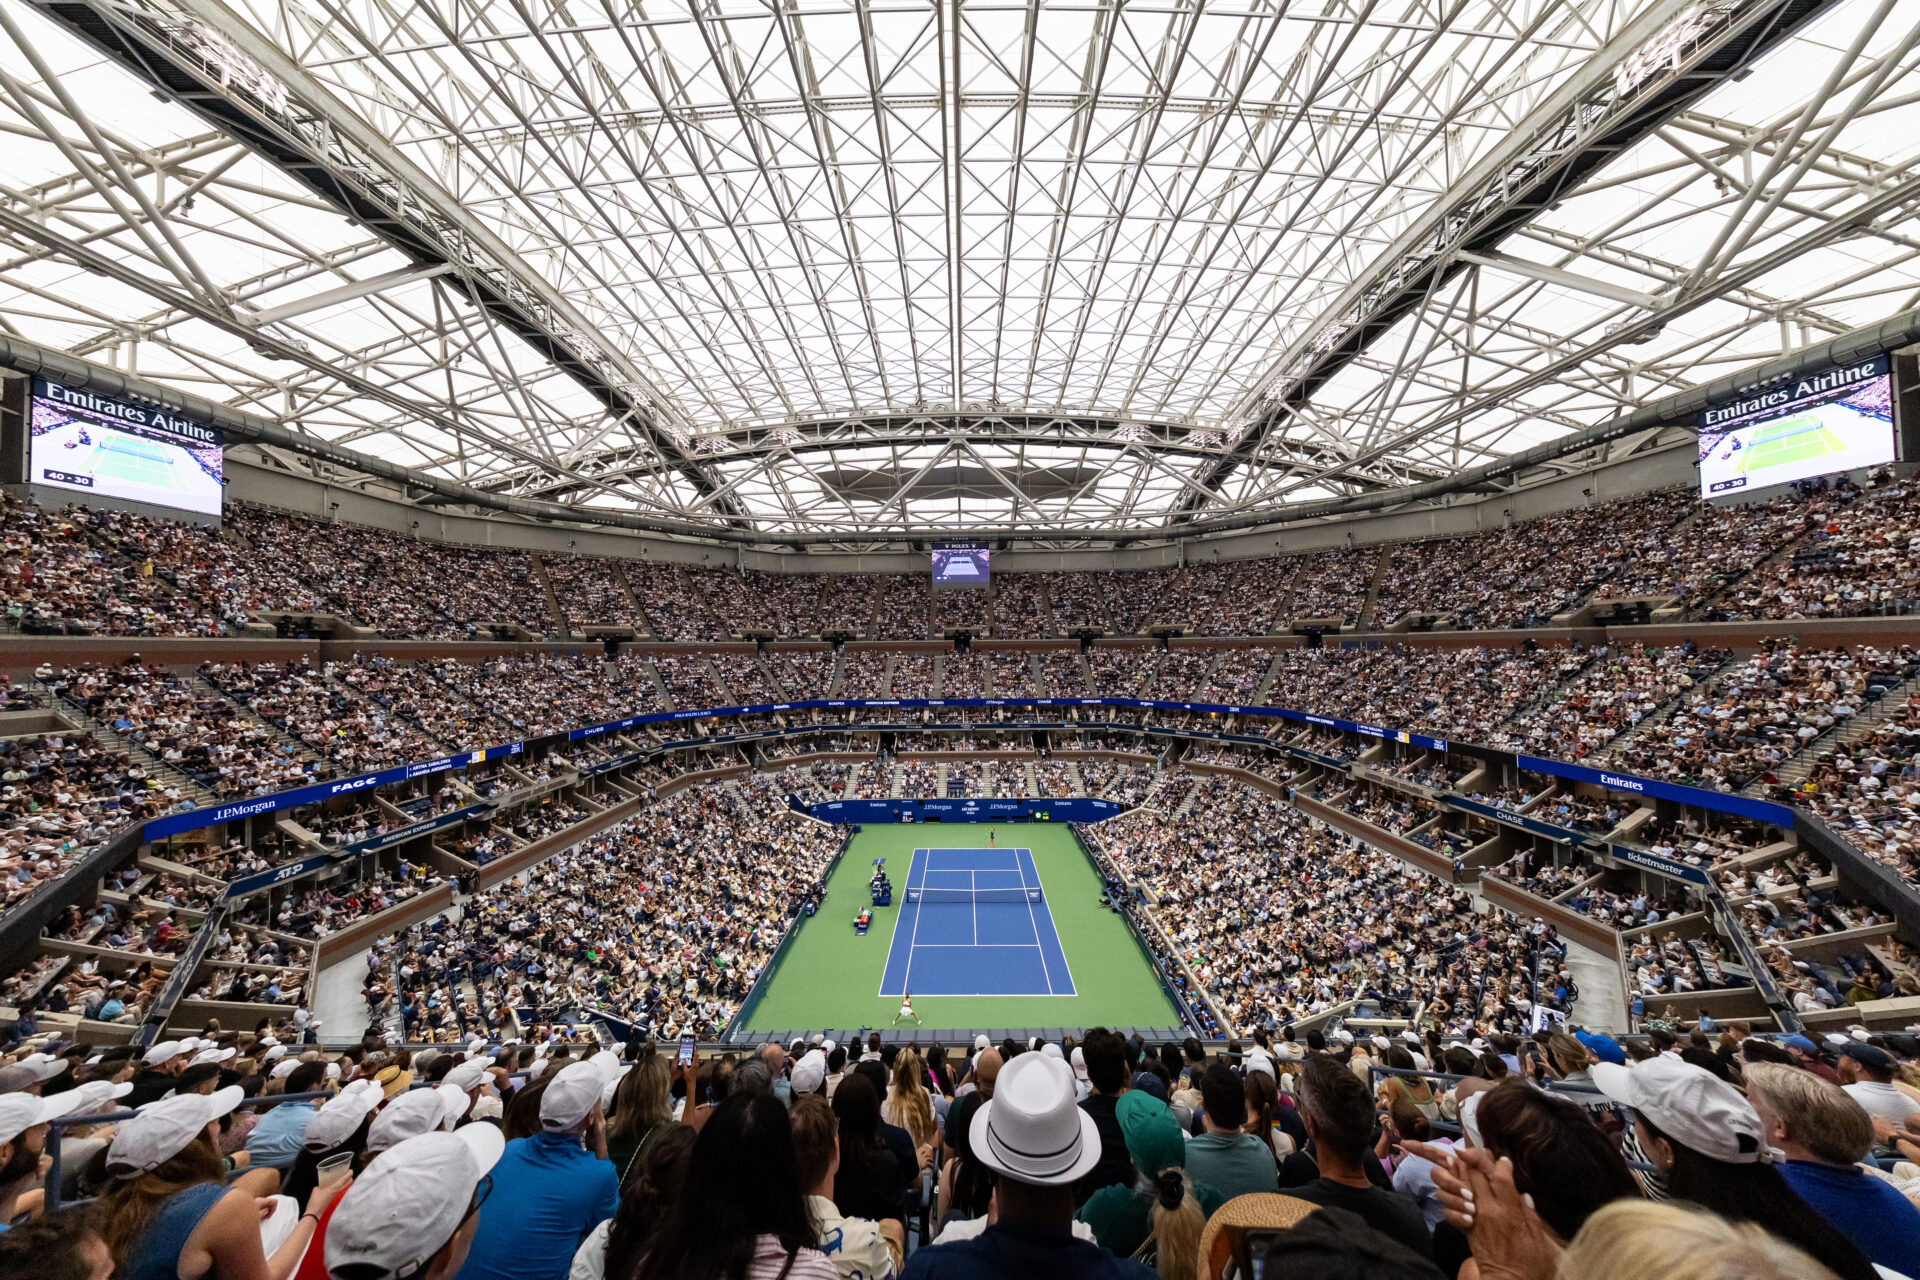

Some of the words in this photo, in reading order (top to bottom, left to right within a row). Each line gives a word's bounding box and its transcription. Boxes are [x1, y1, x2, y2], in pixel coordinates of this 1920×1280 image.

[1705, 389, 1788, 425] Emirates
[1794, 362, 1875, 398] Airline
[46, 381, 146, 423] Emirates
[151, 413, 215, 442] Airline
[48, 470, 65, 481] 40
[74, 475, 89, 485] 30
[1712, 483, 1725, 491] 40
[1731, 478, 1744, 487] 30
[584, 726, 604, 735] CHUBB
[1433, 743, 1445, 751] IBM
[332, 777, 377, 793] FAGE
[1601, 773, 1643, 791] Emirates
[213, 800, 276, 821] J.P.Morgan
[1496, 811, 1524, 826] CHASE
[381, 828, 412, 844] AMERICAN
[412, 821, 437, 835] EXPRESS
[1627, 851, 1684, 876] ticketmaster
[273, 863, 304, 882] ATP
[1594, 1101, 1612, 1113] my
